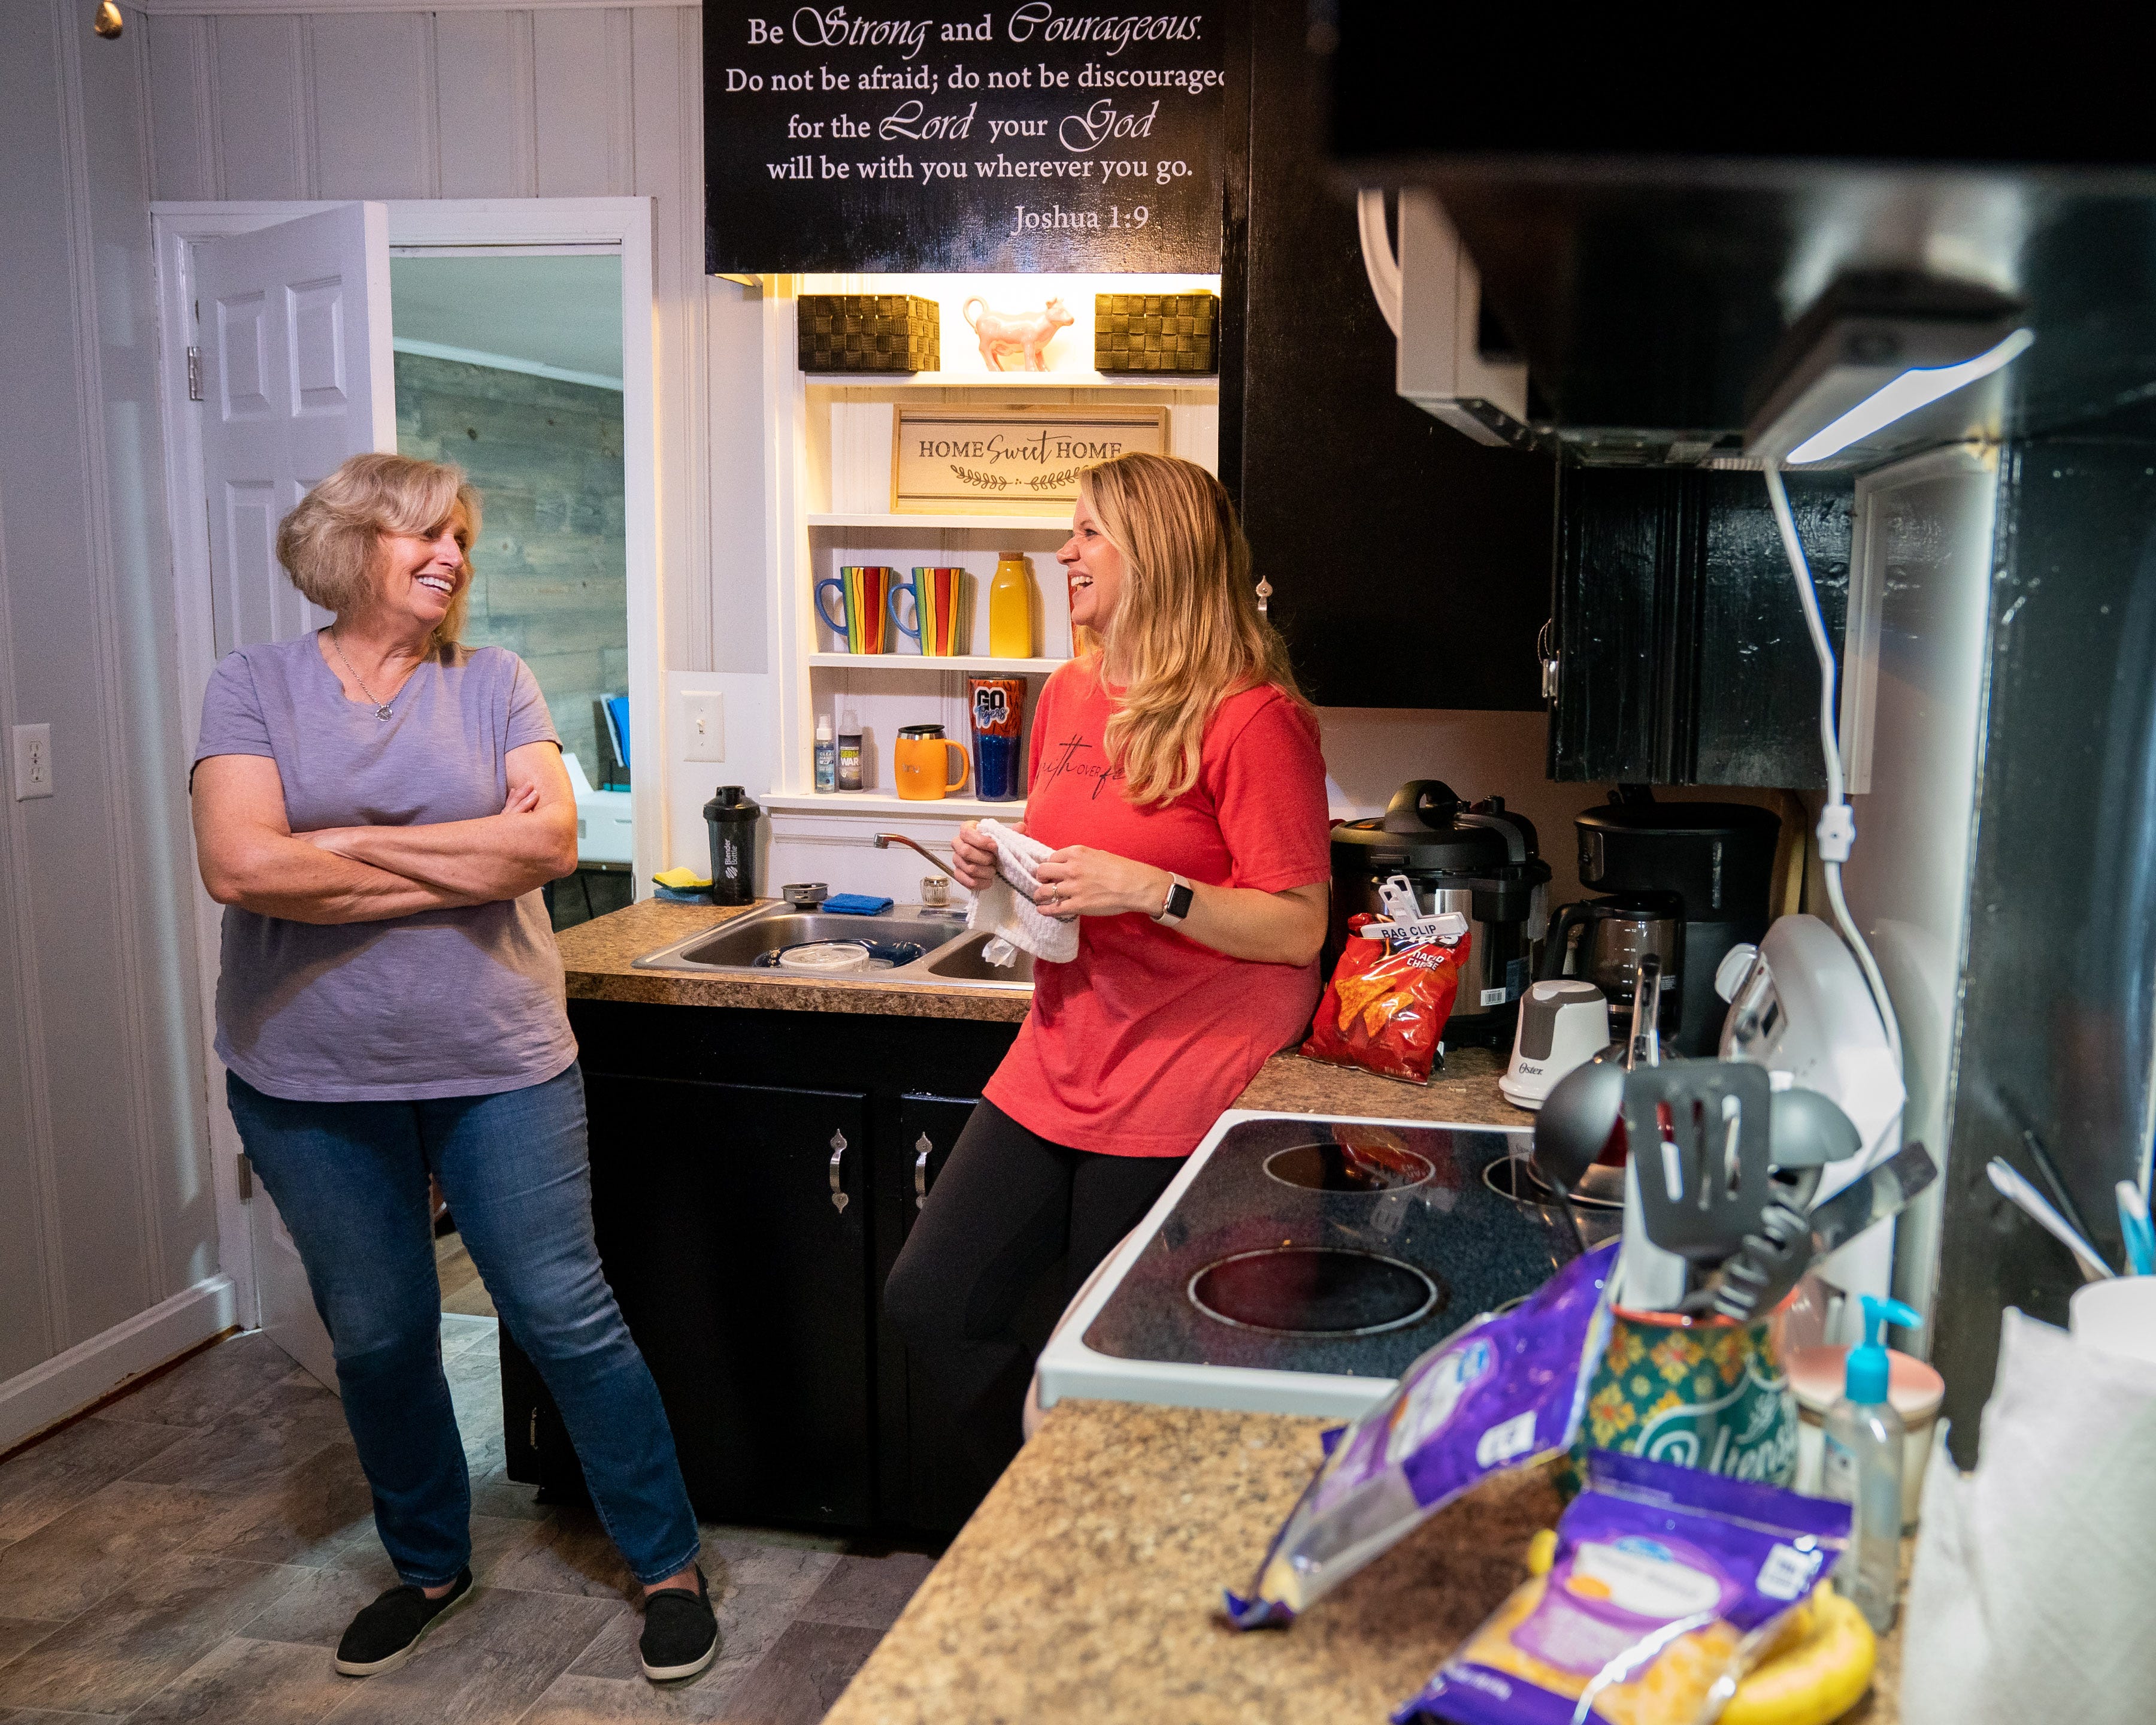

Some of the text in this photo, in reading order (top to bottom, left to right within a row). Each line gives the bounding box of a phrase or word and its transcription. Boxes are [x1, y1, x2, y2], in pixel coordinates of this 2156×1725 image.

[747, 2, 1202, 60] Be Strong and Courageous.
[725, 68, 764, 92] Do
[771, 70, 814, 91] not
[820, 66, 850, 90] be
[858, 65, 938, 95] afraid;
[947, 64, 980, 89] do
[988, 67, 1032, 88] not
[1038, 63, 1070, 87] be
[788, 98, 1160, 153] for the Lord your God
[766, 153, 1194, 186] will be with you wherever you go.
[1010, 205, 1150, 237] Joshua 1:9
[919, 430, 1122, 465] HOME Sweet HOME
[976, 689, 1005, 712] GO
[974, 703, 1009, 727] Tigers
[1077, 764, 1101, 777] OVER
[1381, 924, 1437, 939] BAG CLIP
[1406, 958, 1439, 971] CHESE
[1519, 1062, 1543, 1075] Oster
